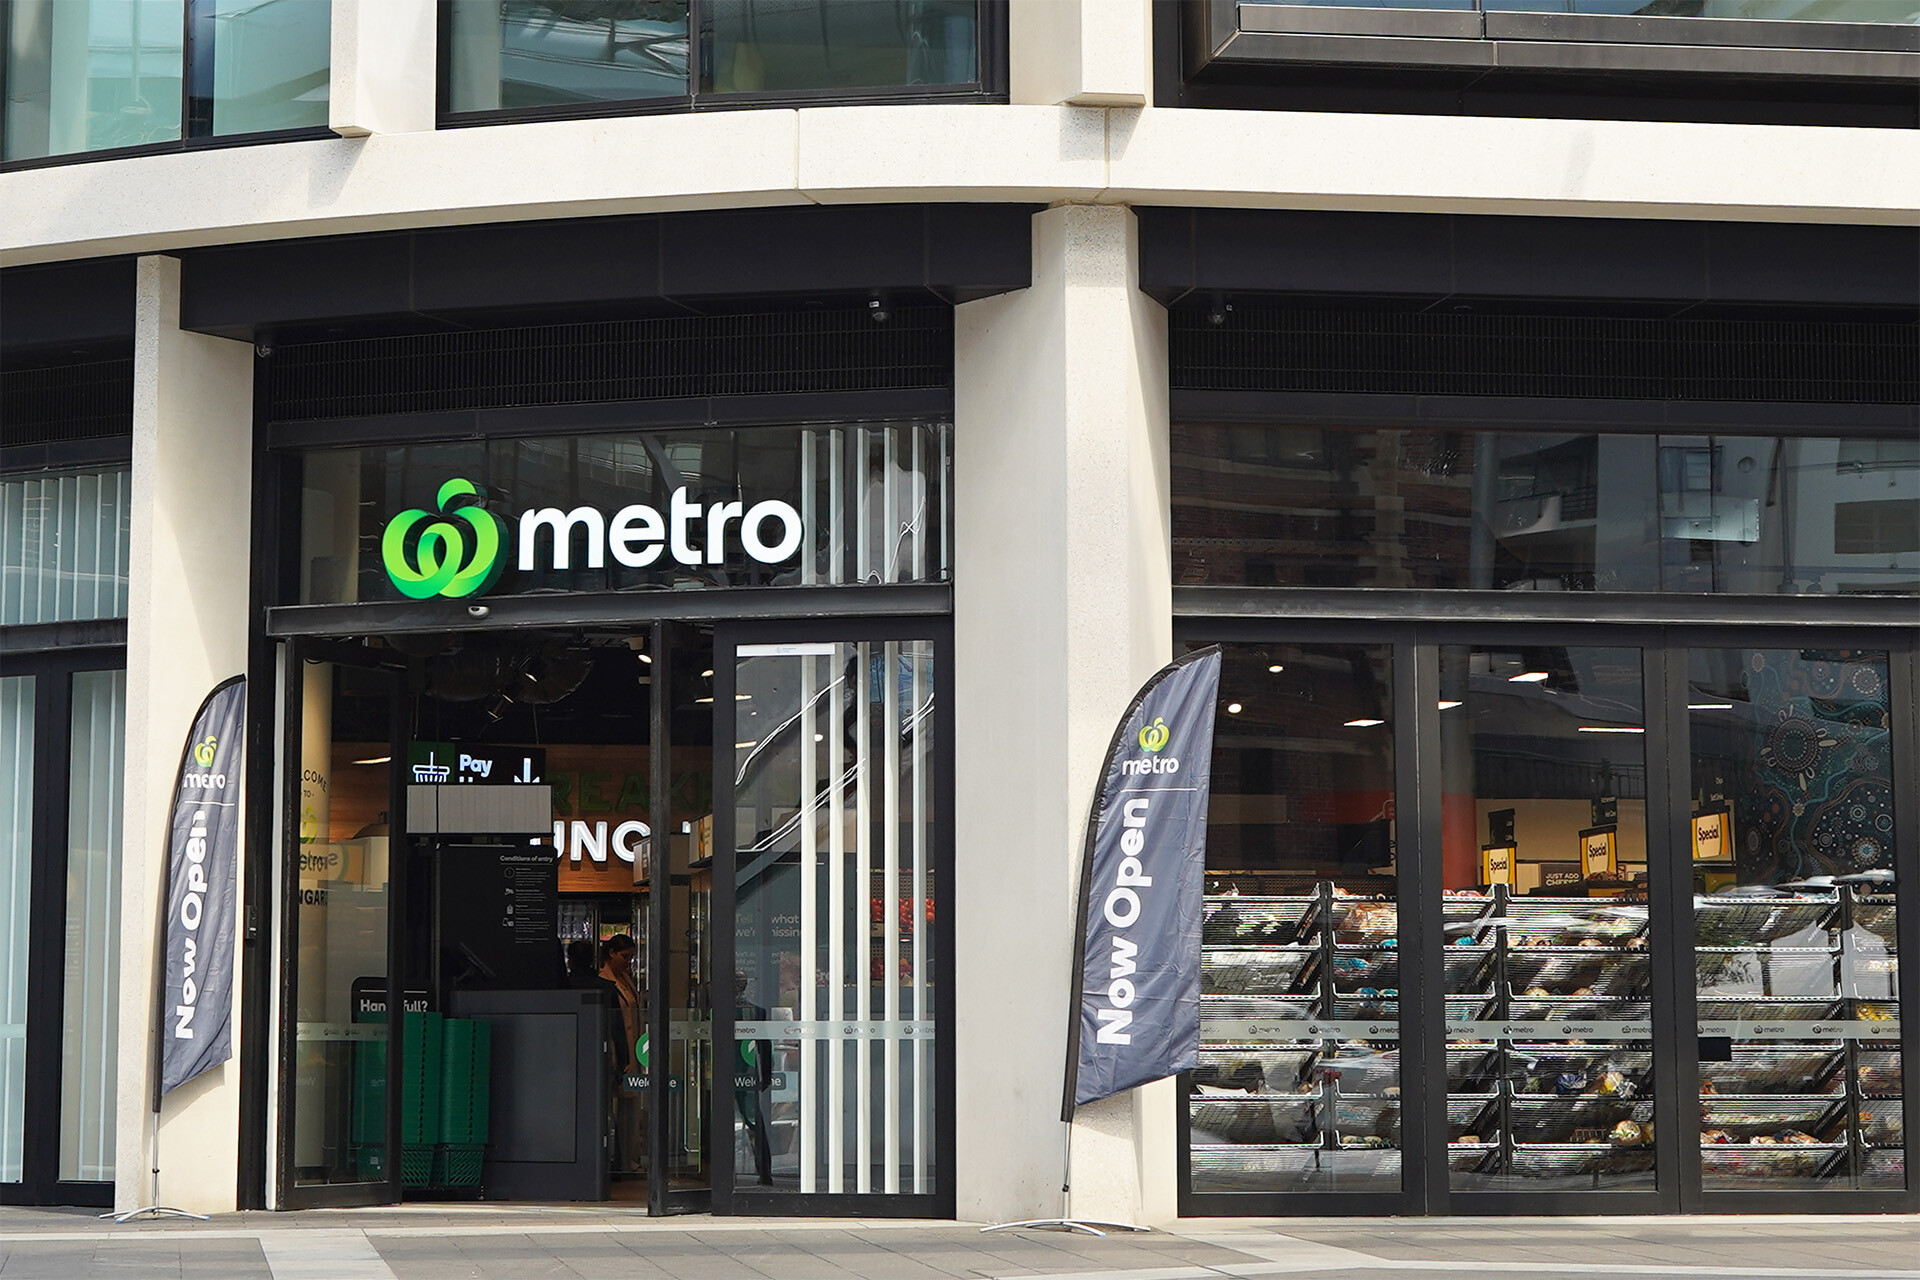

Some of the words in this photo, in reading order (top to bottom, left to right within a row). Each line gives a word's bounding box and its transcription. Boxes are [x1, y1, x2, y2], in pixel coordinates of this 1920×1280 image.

[518, 485, 804, 571] metro
[459, 754, 493, 778] Pay
[1122, 755, 1179, 776] metro
[184, 773, 226, 789] mero
[300, 769, 327, 793] COME
[1698, 824, 1719, 845] Special
[299, 850, 324, 872] etro
[1588, 842, 1607, 862] Special
[181, 809, 208, 931] Open
[1104, 797, 1152, 929] Open
[1490, 858, 1507, 873] Special
[771, 914, 800, 924] what
[771, 926, 800, 937] issin
[175, 936, 197, 1040] Now
[1096, 936, 1140, 1046] Now
[360, 999, 387, 1012] Han
[403, 999, 428, 1012] full?
[734, 1026, 756, 1034] metro
[1512, 1026, 1535, 1034] metro
[1572, 1026, 1594, 1034] metro
[628, 1077, 677, 1088] Wele
